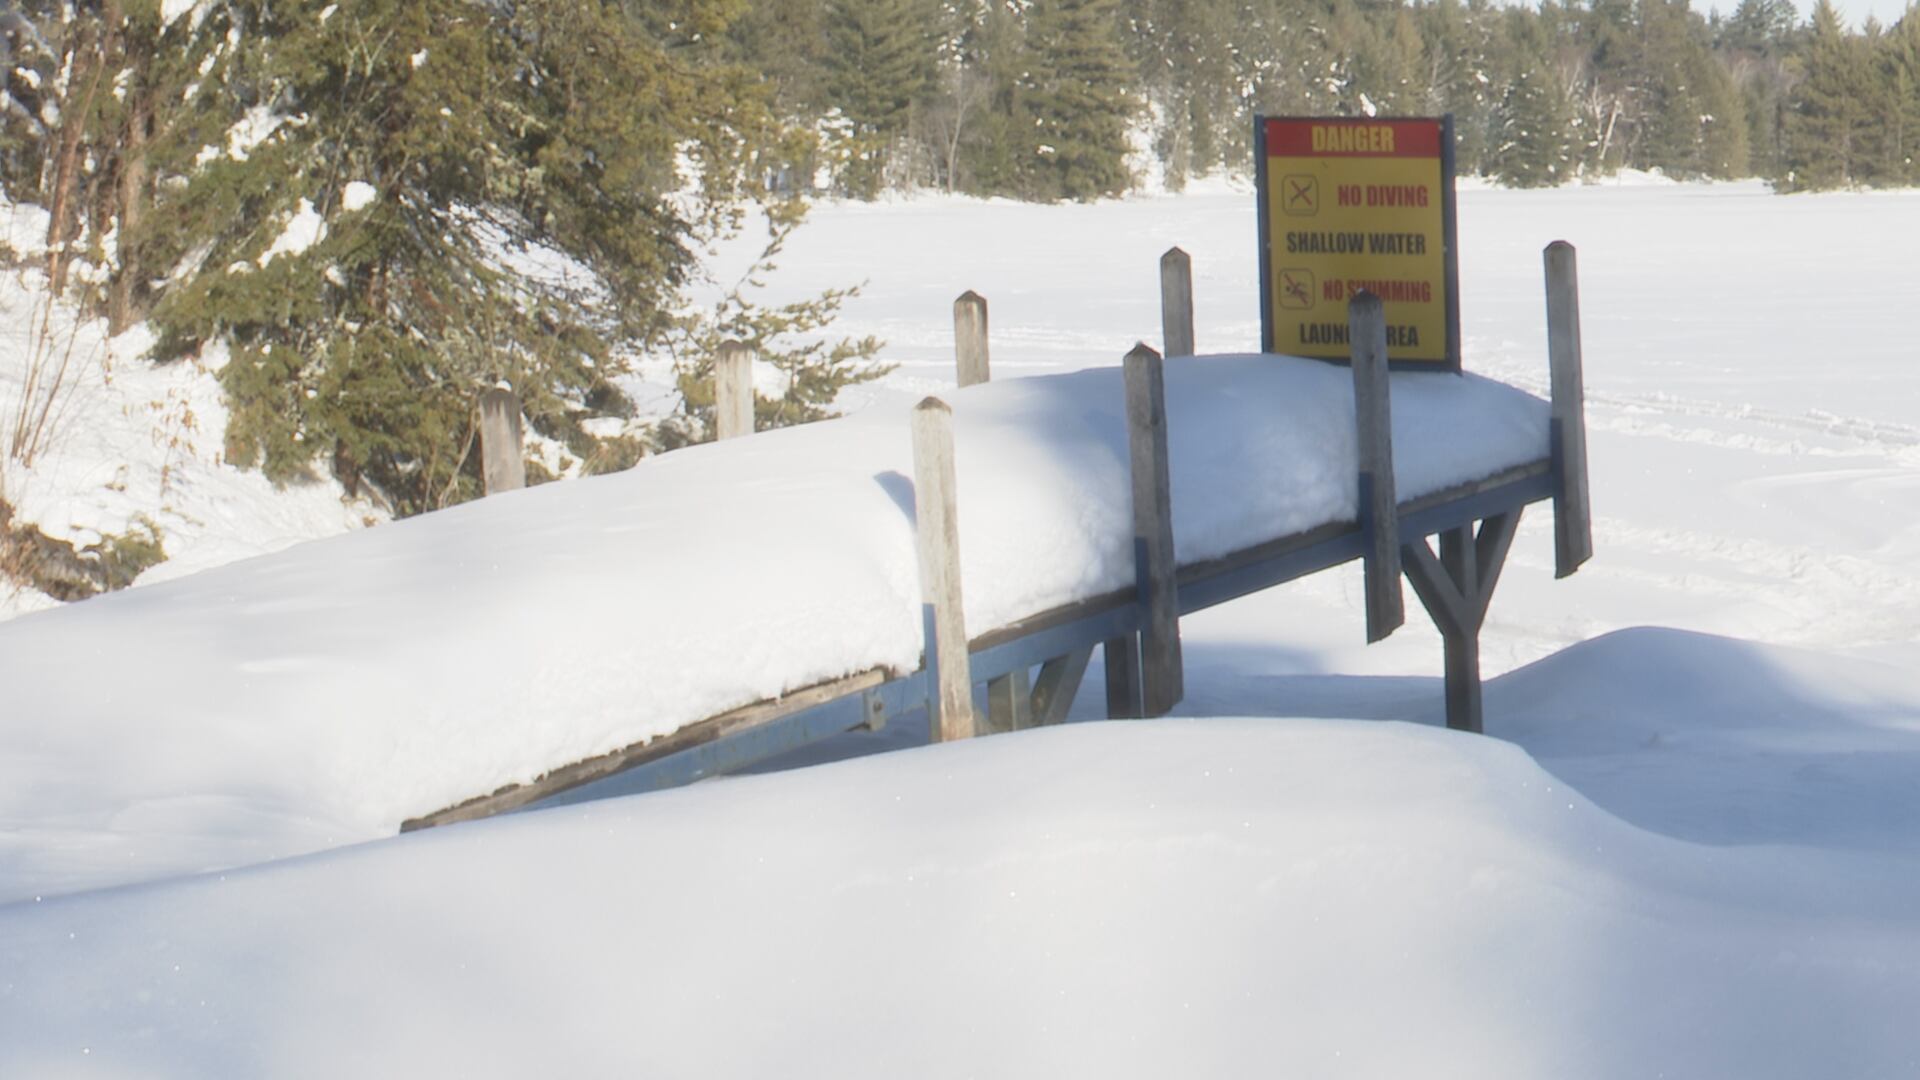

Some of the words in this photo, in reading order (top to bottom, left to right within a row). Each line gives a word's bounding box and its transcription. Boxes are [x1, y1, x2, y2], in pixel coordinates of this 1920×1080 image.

[1311, 125, 1395, 152] DANGER
[1338, 185, 1362, 208] NO
[1366, 184, 1429, 209] DIVING
[1286, 231, 1364, 254] SHALLOW
[1369, 233, 1426, 255] WATER
[1323, 279, 1344, 301] NO
[1300, 323, 1350, 346] LAUN
[1385, 325, 1419, 347] REA
